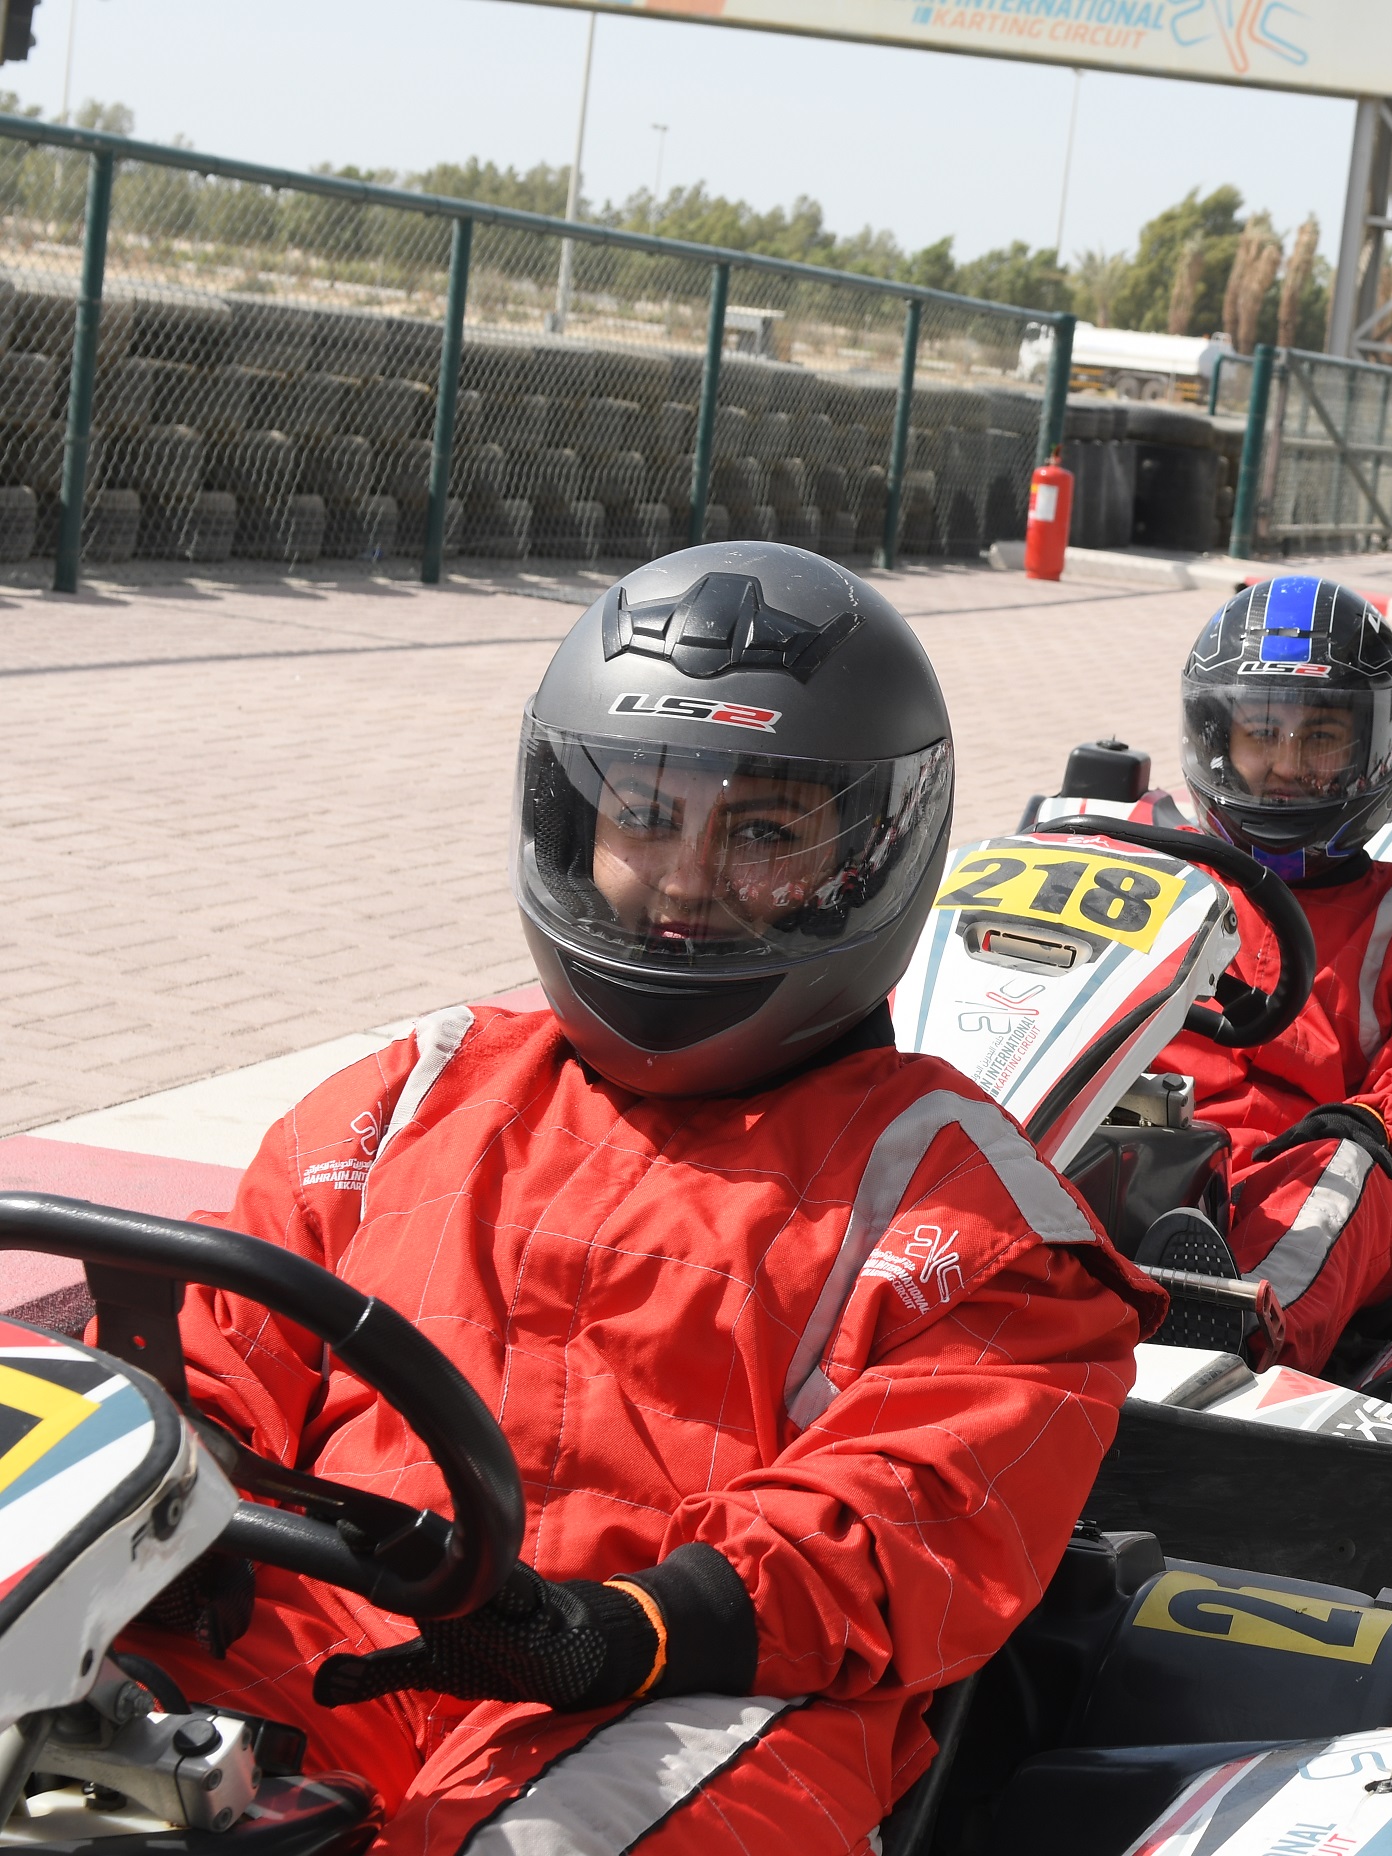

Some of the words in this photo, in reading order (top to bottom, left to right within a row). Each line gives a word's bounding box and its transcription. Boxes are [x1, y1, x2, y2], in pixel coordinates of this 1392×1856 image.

[931, 6, 1046, 39] KARTING
[1048, 19, 1148, 49] CIRCUIT
[1237, 661, 1332, 679] LS2
[608, 693, 783, 734] LS2
[935, 857, 1162, 933] 218
[985, 1016, 1036, 1079] INTERNATIONAL
[994, 1054, 1022, 1091] KARTING
[1017, 1025, 1041, 1055] CIRCUIT
[302, 1170, 350, 1186] BAHRAIN
[892, 1280, 916, 1309] CIRCUIT
[1168, 1589, 1363, 1647] 2
